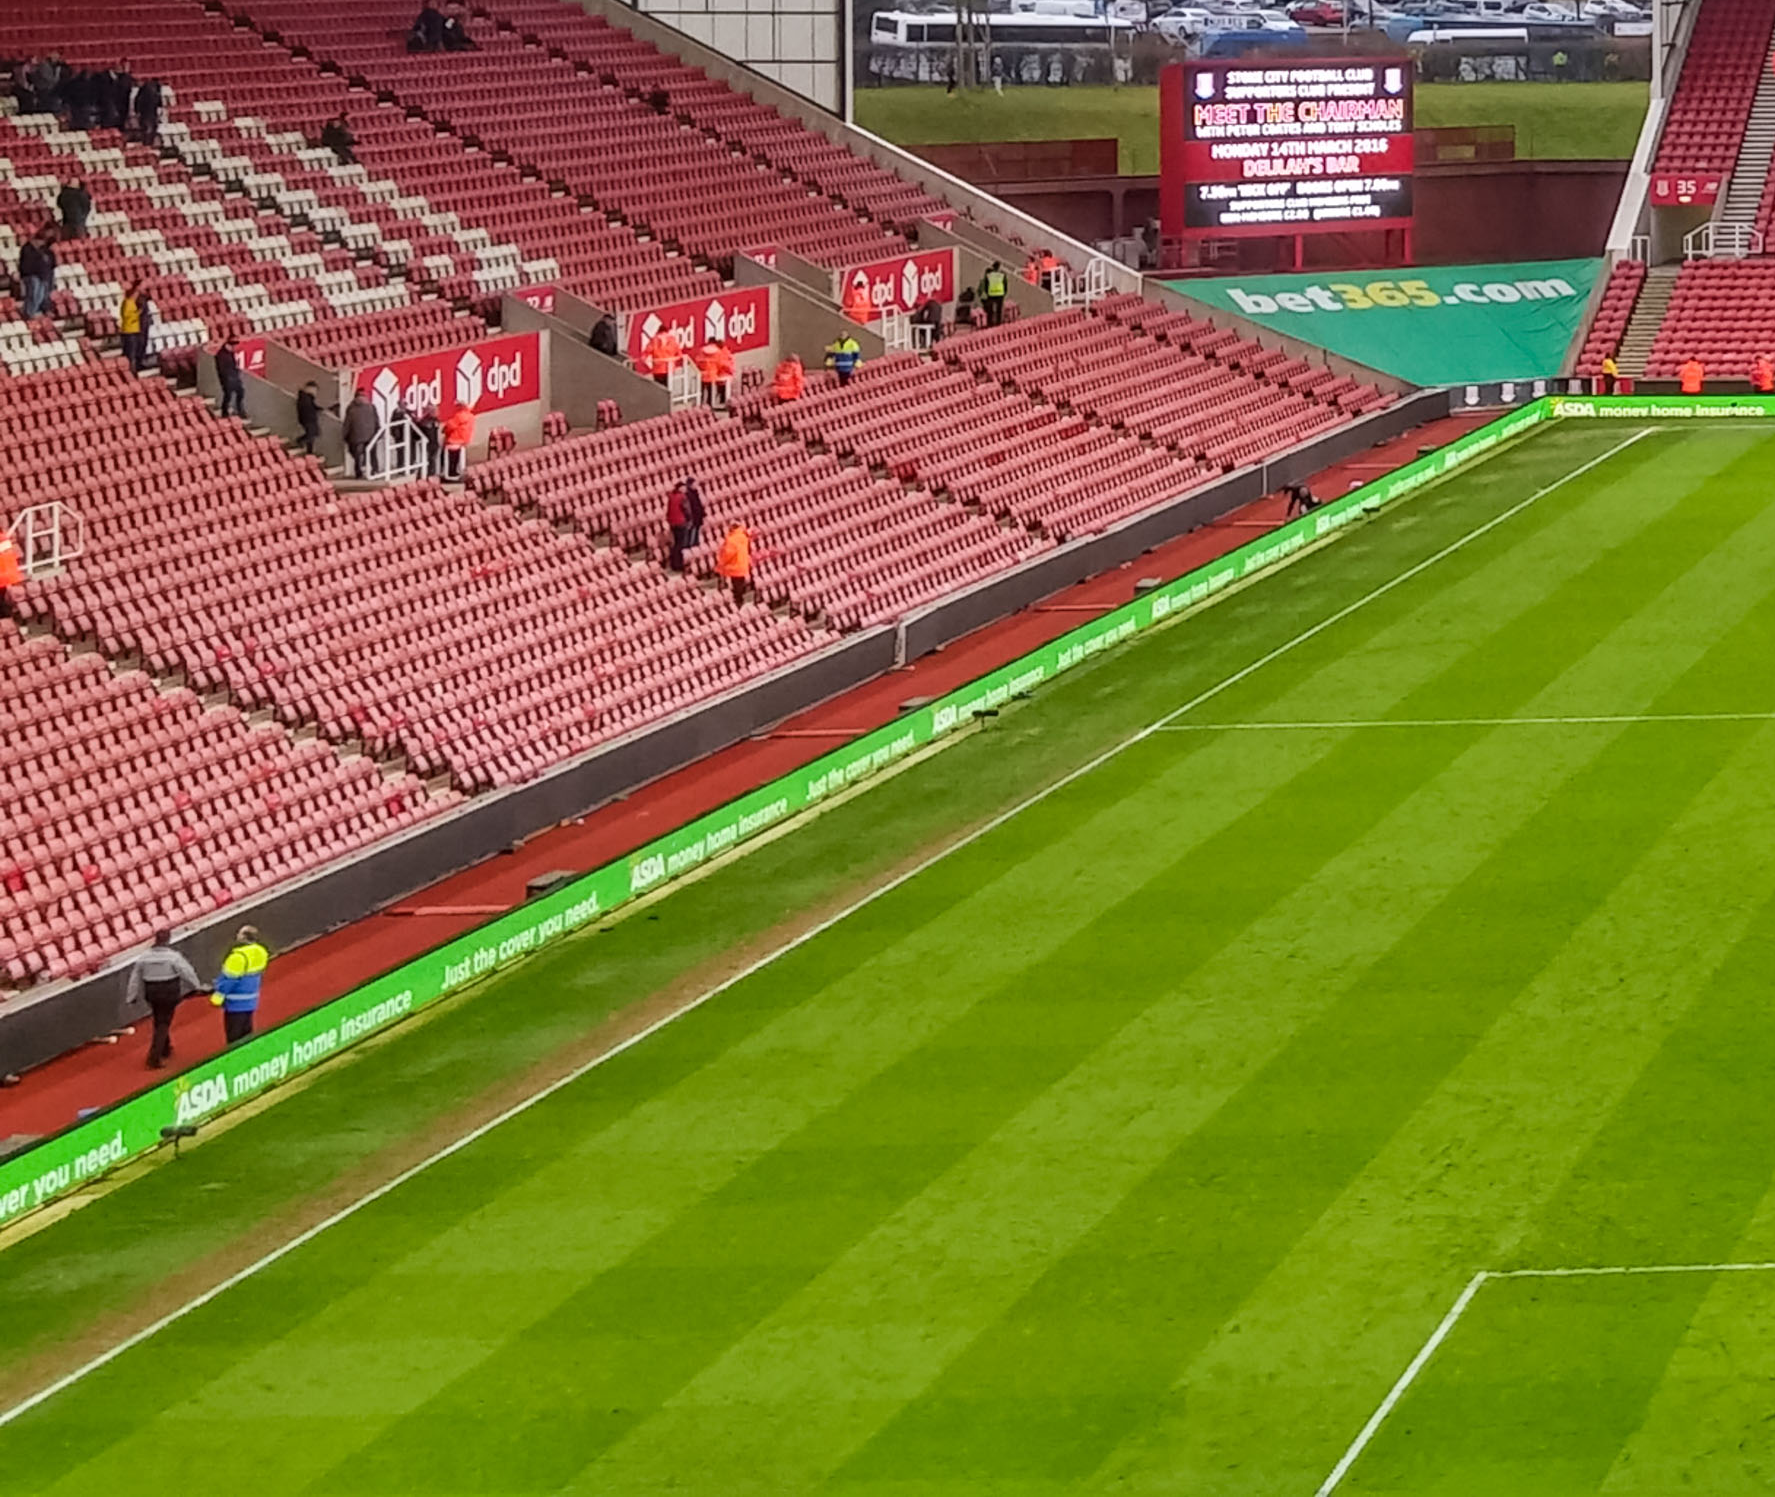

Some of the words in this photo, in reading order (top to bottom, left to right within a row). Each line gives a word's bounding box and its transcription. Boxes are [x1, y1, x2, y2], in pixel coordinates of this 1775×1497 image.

[1194, 103, 1250, 125] MEET
[1252, 102, 1295, 124] THE
[1299, 99, 1404, 122] CHAIRMAN
[1211, 143, 1270, 159] MONDAY
[1271, 142, 1306, 157] 14TH
[1308, 140, 1353, 154] MARCH
[1354, 138, 1388, 152] 2016
[1243, 157, 1324, 177] DELILAH'S
[1325, 156, 1360, 174] BAR
[1677, 180, 1697, 195] 35
[872, 274, 895, 308] dpd
[920, 263, 943, 298] dpd
[1227, 277, 1578, 314] bet365.com
[728, 302, 755, 344] dpd
[487, 351, 522, 399] dpd
[405, 369, 442, 419] dpd
[1553, 402, 1596, 417] ASDA
[1599, 405, 1649, 418] money
[1650, 404, 1693, 417] home
[1696, 404, 1765, 417] insurance
[630, 854, 666, 892] ASDA
[667, 838, 705, 874] money
[706, 823, 737, 850] home
[738, 798, 789, 836] insurance
[441, 961, 472, 990] Just
[473, 946, 497, 973] the
[499, 927, 537, 961] cover
[538, 915, 563, 943] you
[564, 890, 600, 928] need.
[176, 1074, 229, 1127] ASDA
[233, 1051, 291, 1097] money
[292, 1029, 338, 1066] home
[340, 989, 414, 1042] insurance
[33, 1163, 71, 1204] you
[75, 1130, 128, 1180] need.
